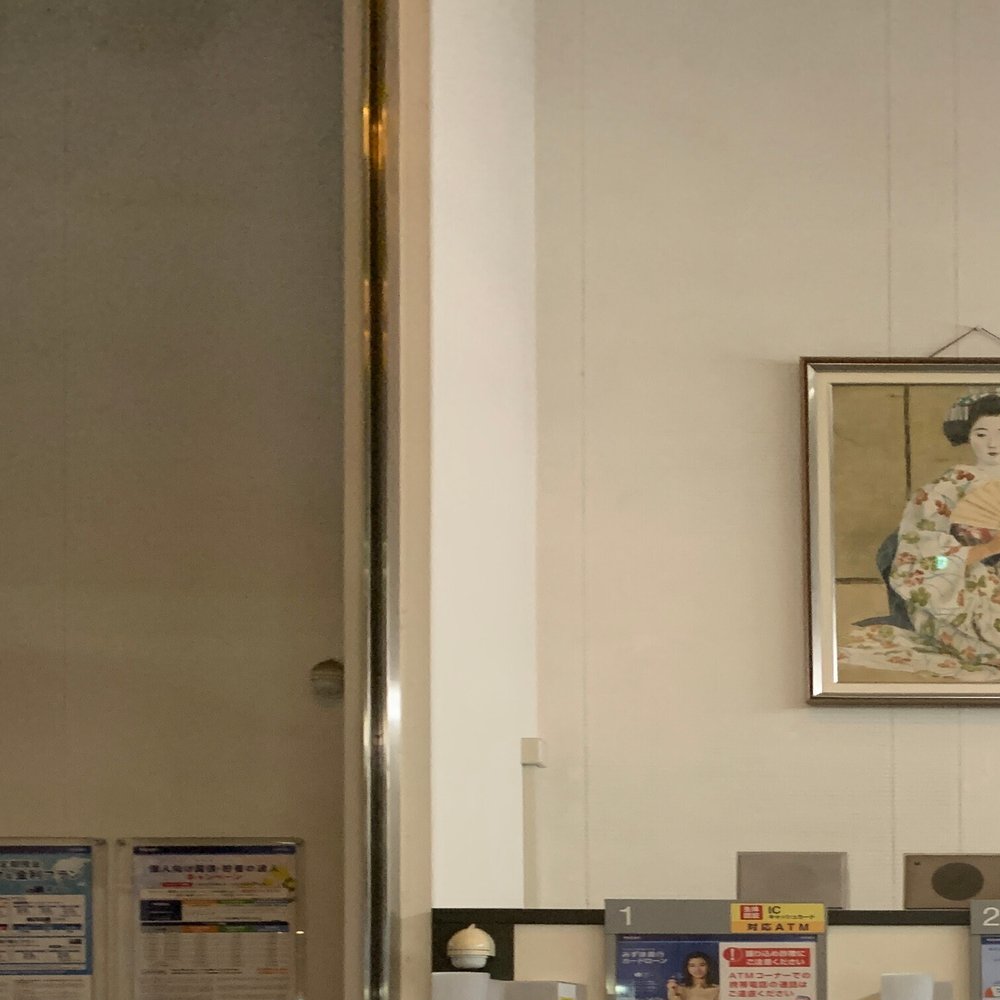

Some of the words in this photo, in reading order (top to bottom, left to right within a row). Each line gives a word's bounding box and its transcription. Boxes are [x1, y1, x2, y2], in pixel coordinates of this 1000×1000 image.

[619, 906, 632, 925] 1
[768, 905, 781, 914] IC
[982, 907, 1000, 926] 2
